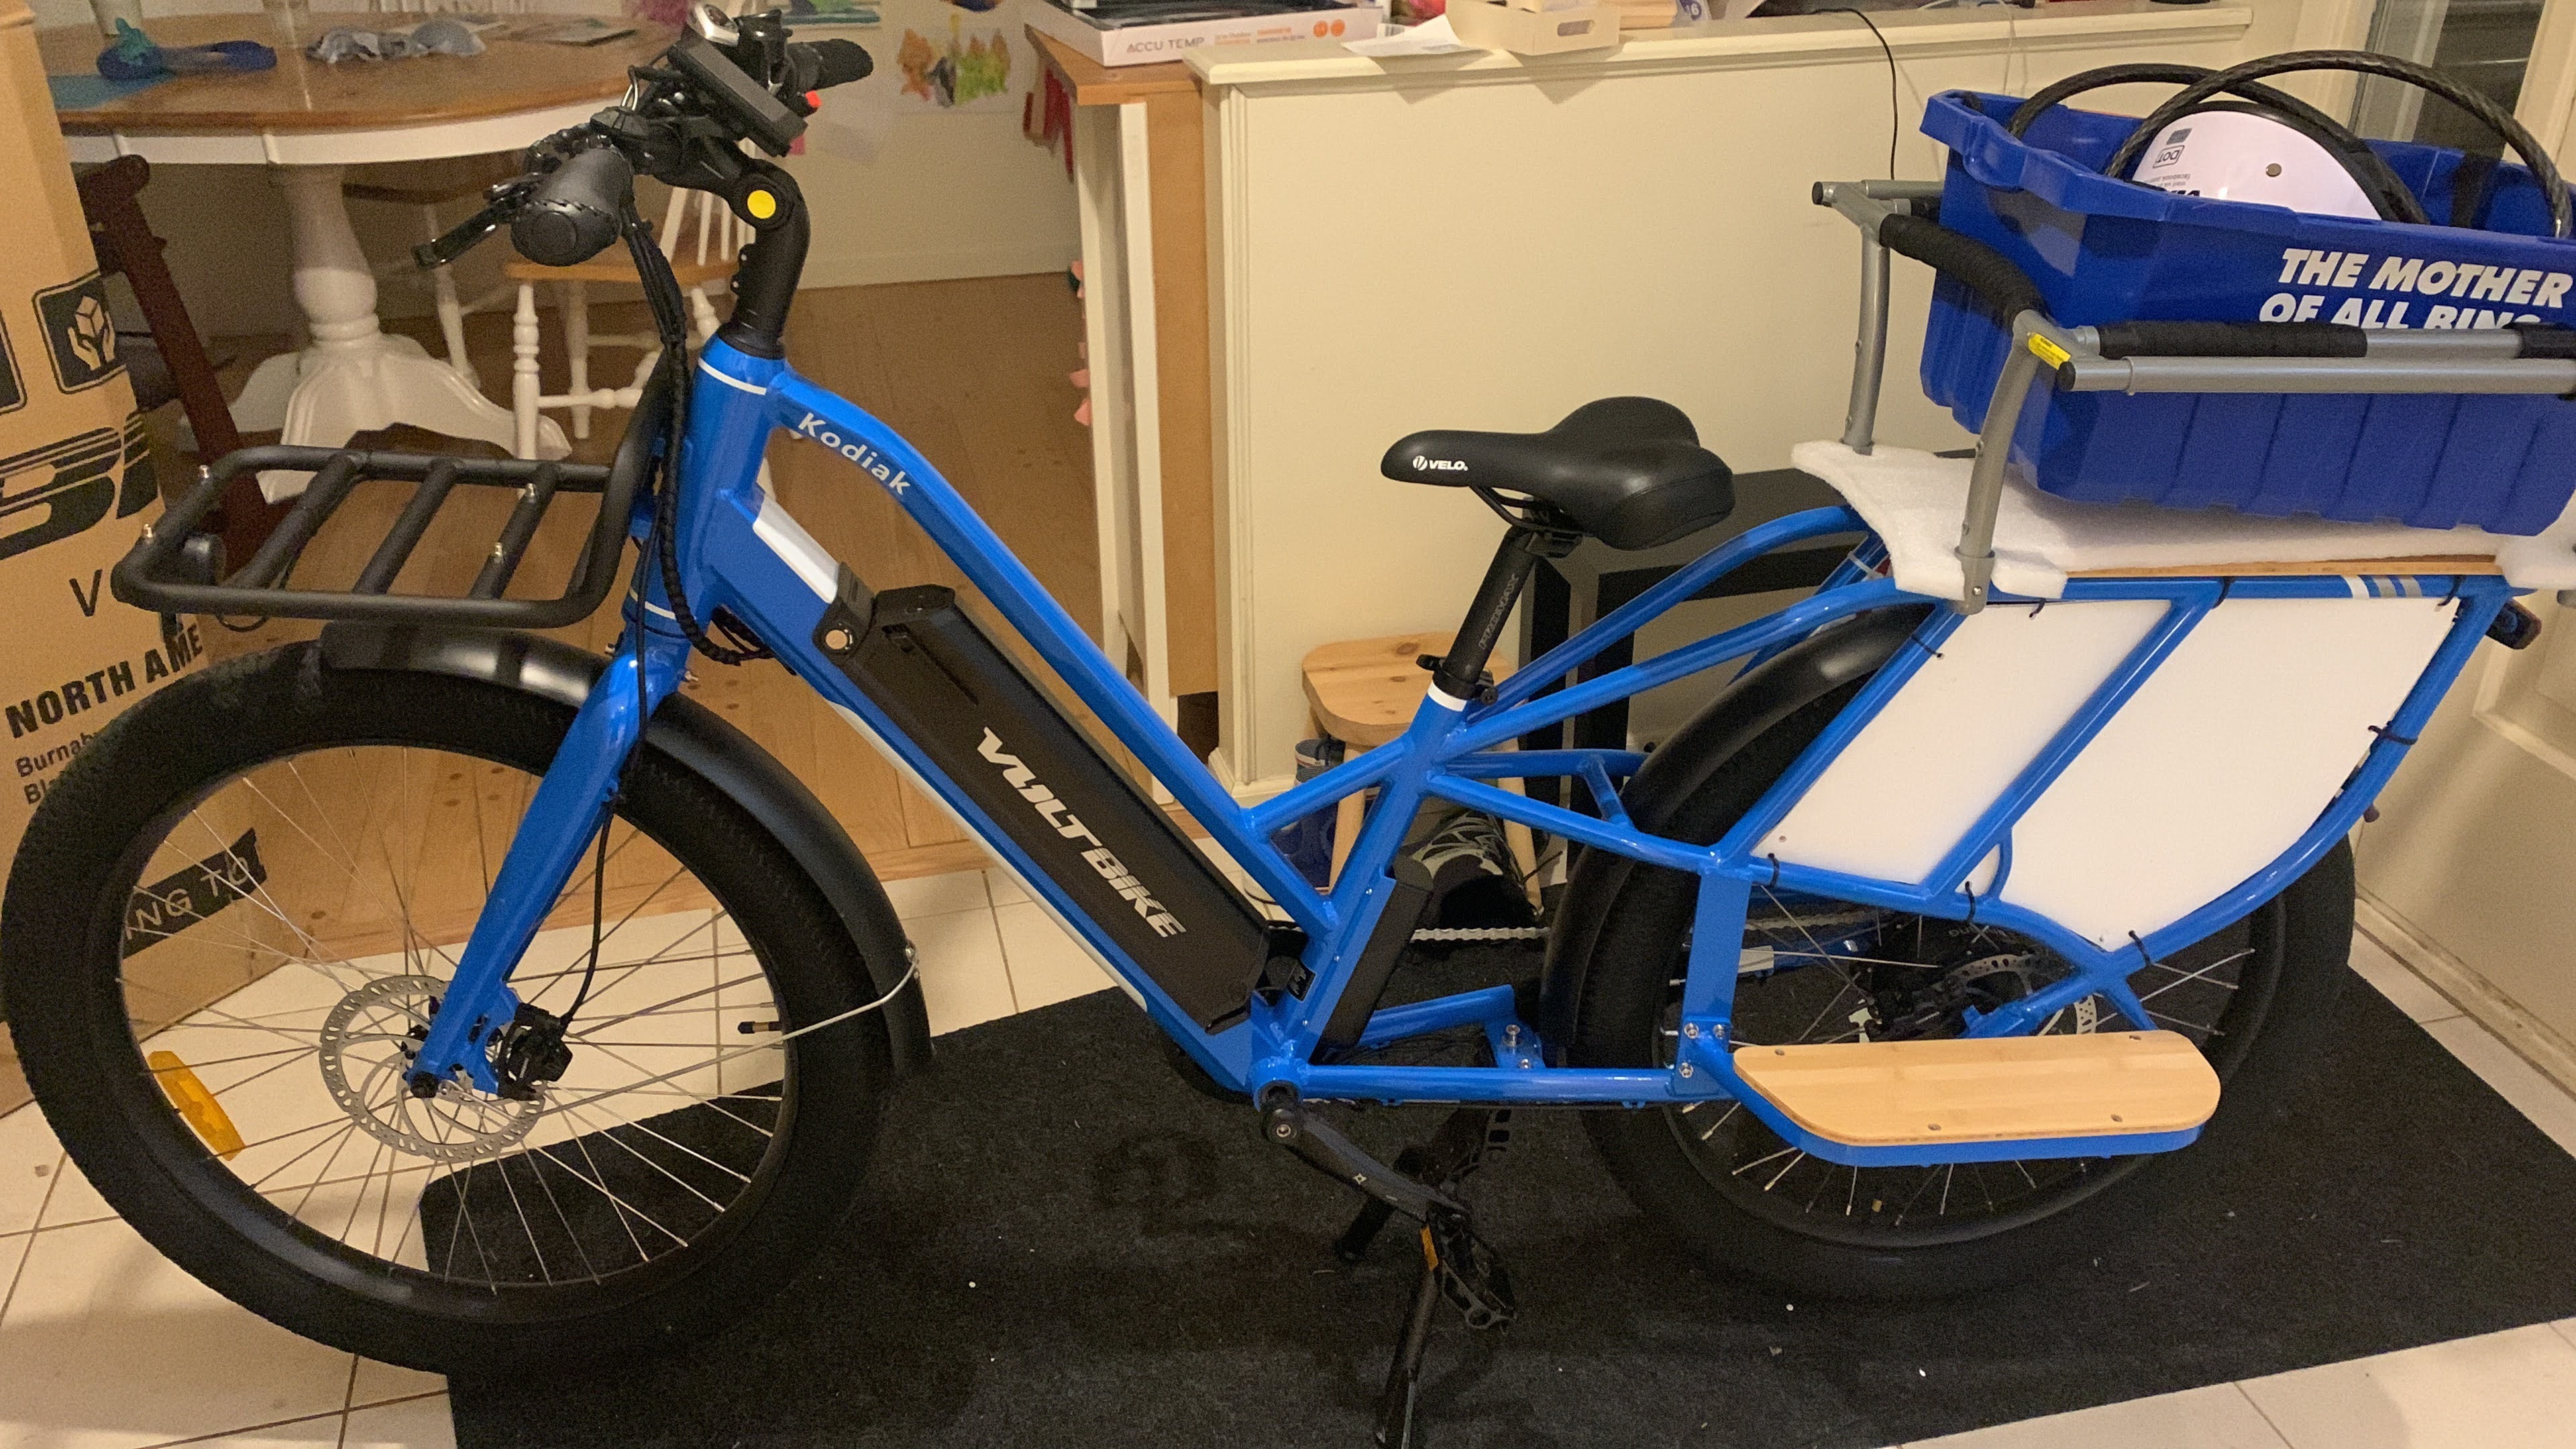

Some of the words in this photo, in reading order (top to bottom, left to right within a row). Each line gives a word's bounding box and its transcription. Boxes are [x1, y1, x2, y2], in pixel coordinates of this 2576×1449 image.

[1126, 40, 1164, 53] ACCU
[1167, 37, 1205, 50] TEMP
[2156, 150, 2181, 163] DOT
[2278, 248, 2372, 288] THE
[2367, 256, 2574, 309] MOTHER
[2259, 293, 2325, 323] OF
[2330, 297, 2410, 329] ALL
[2423, 305, 2542, 329] BIN
[798, 412, 911, 495] Kodiak
[5, 660, 136, 738] NORTH
[15, 732, 98, 777] Burnab
